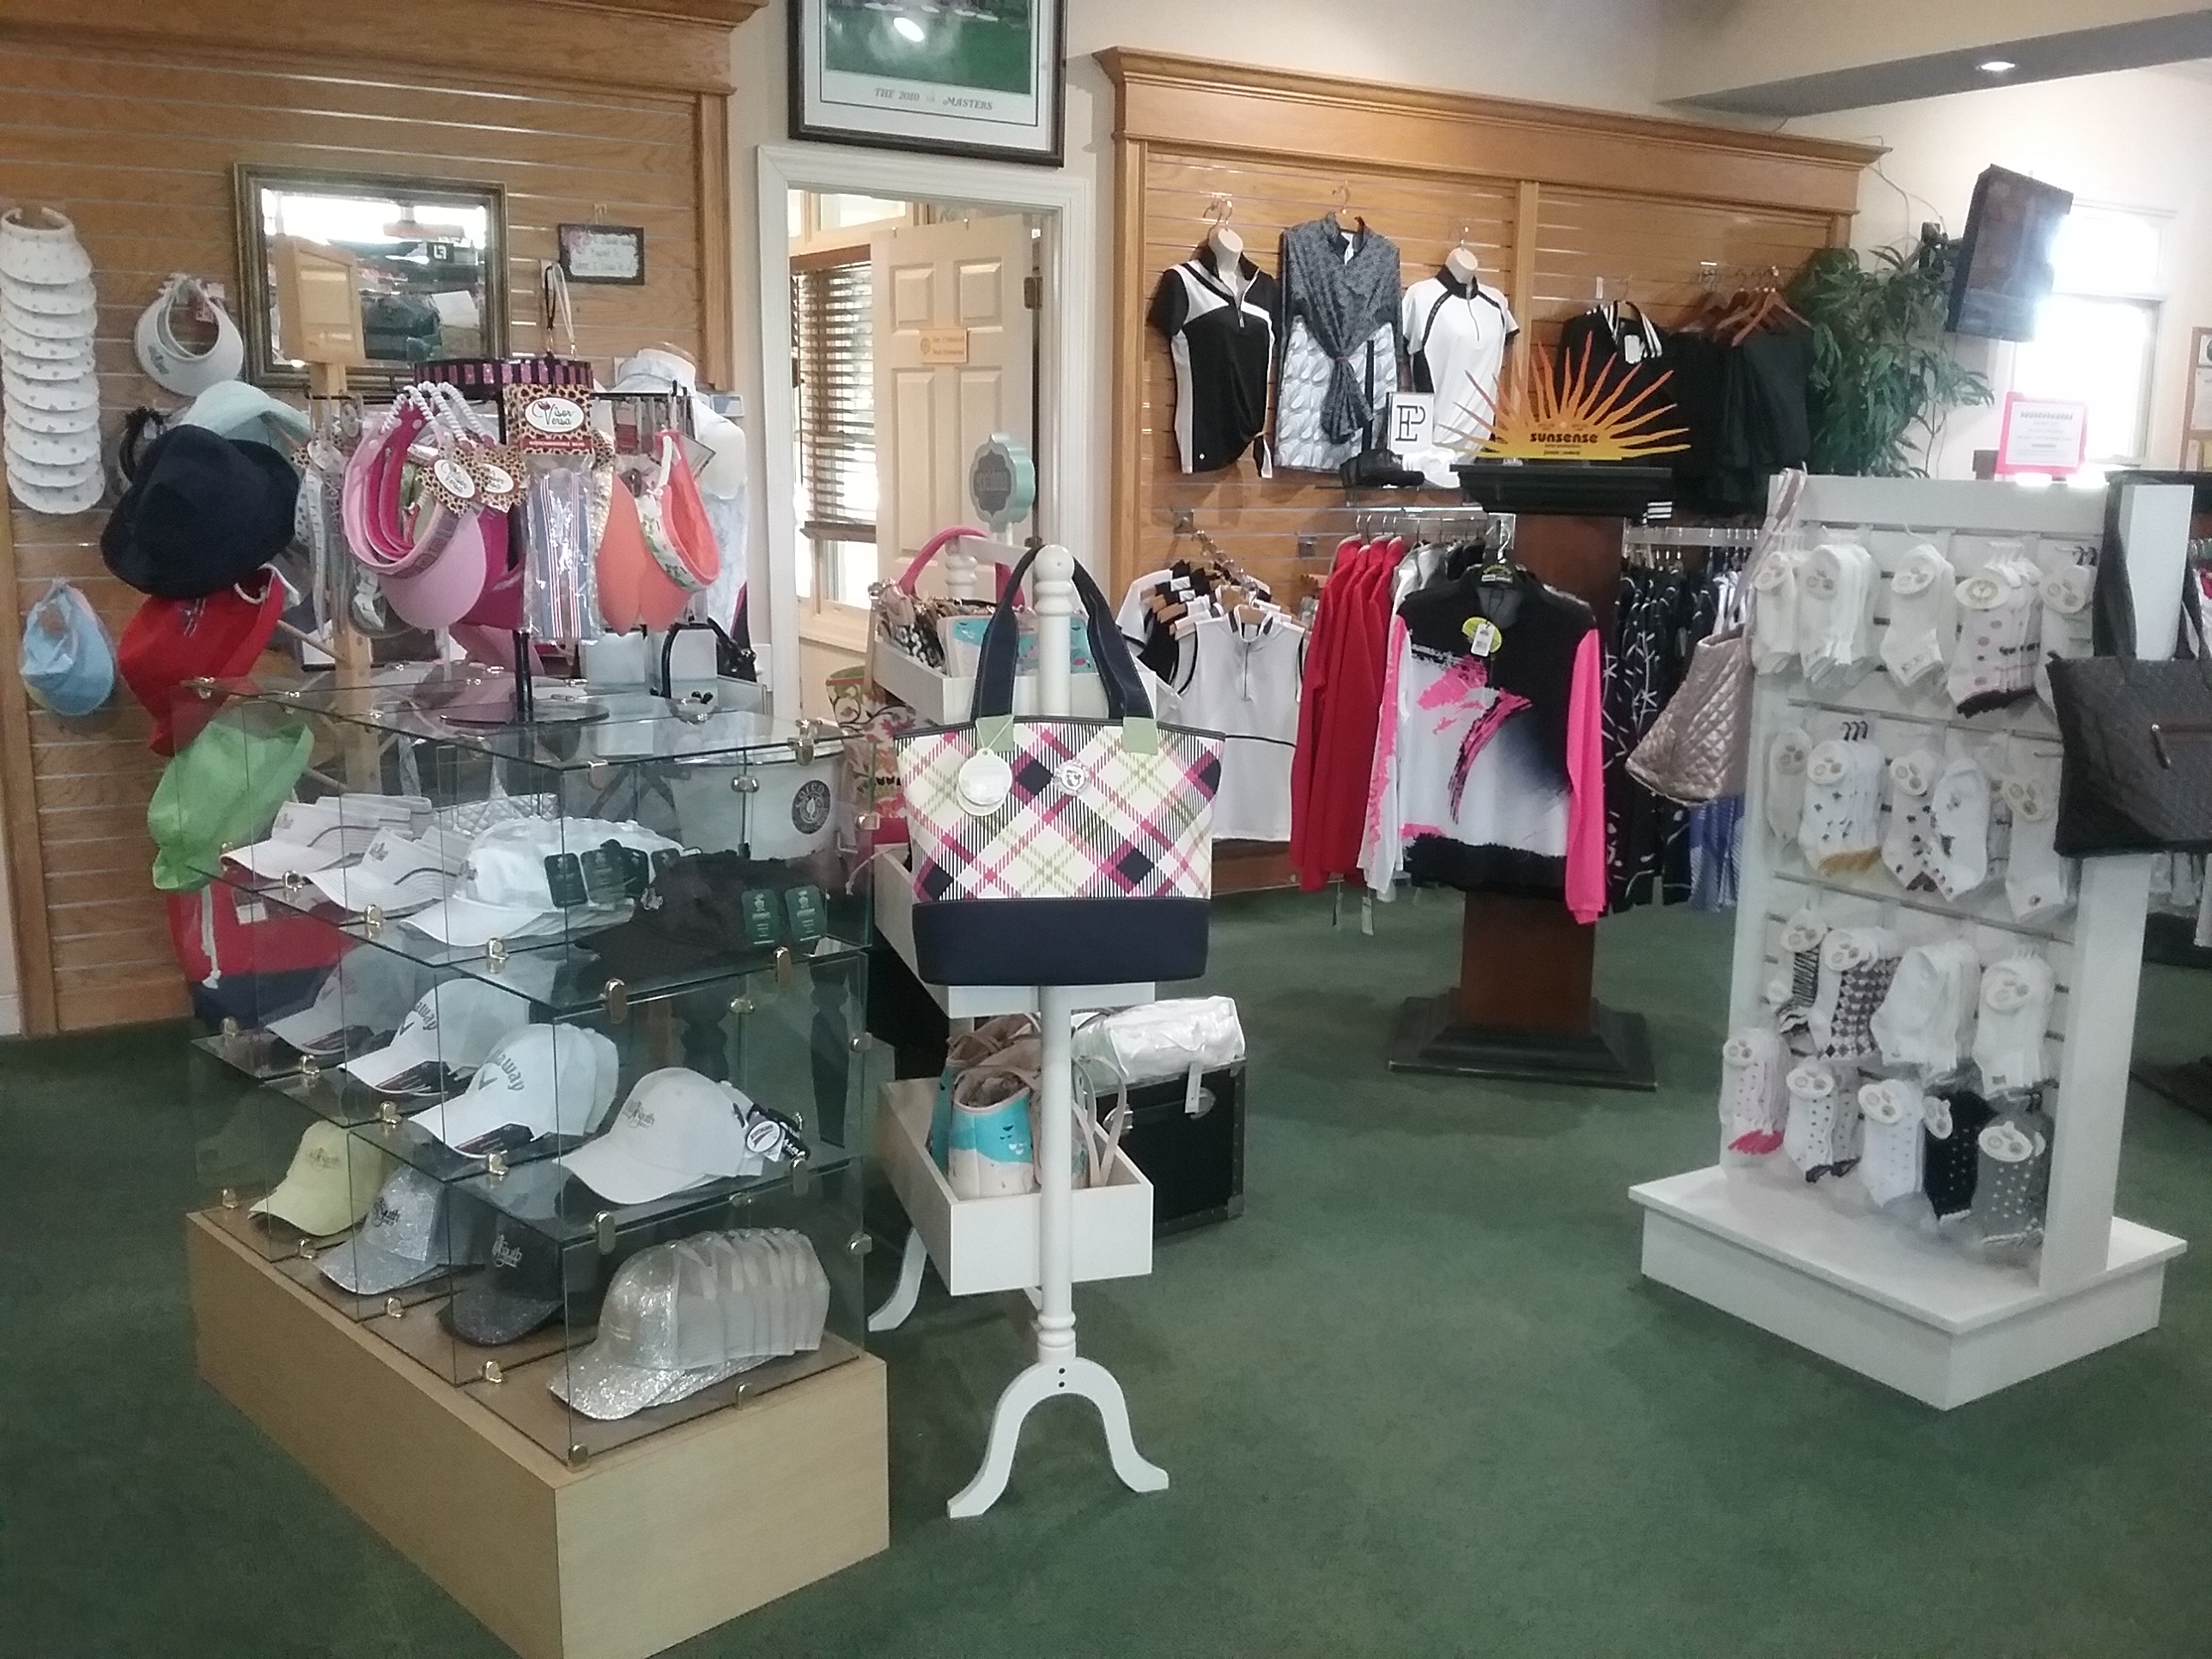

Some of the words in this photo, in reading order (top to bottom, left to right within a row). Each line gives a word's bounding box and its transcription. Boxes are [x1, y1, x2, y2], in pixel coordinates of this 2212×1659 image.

[874, 88, 895, 99] THE
[898, 90, 920, 101] 2010
[943, 96, 993, 110] MASTERS
[1395, 404, 1425, 441] EP
[1529, 432, 1599, 443] sunsense
